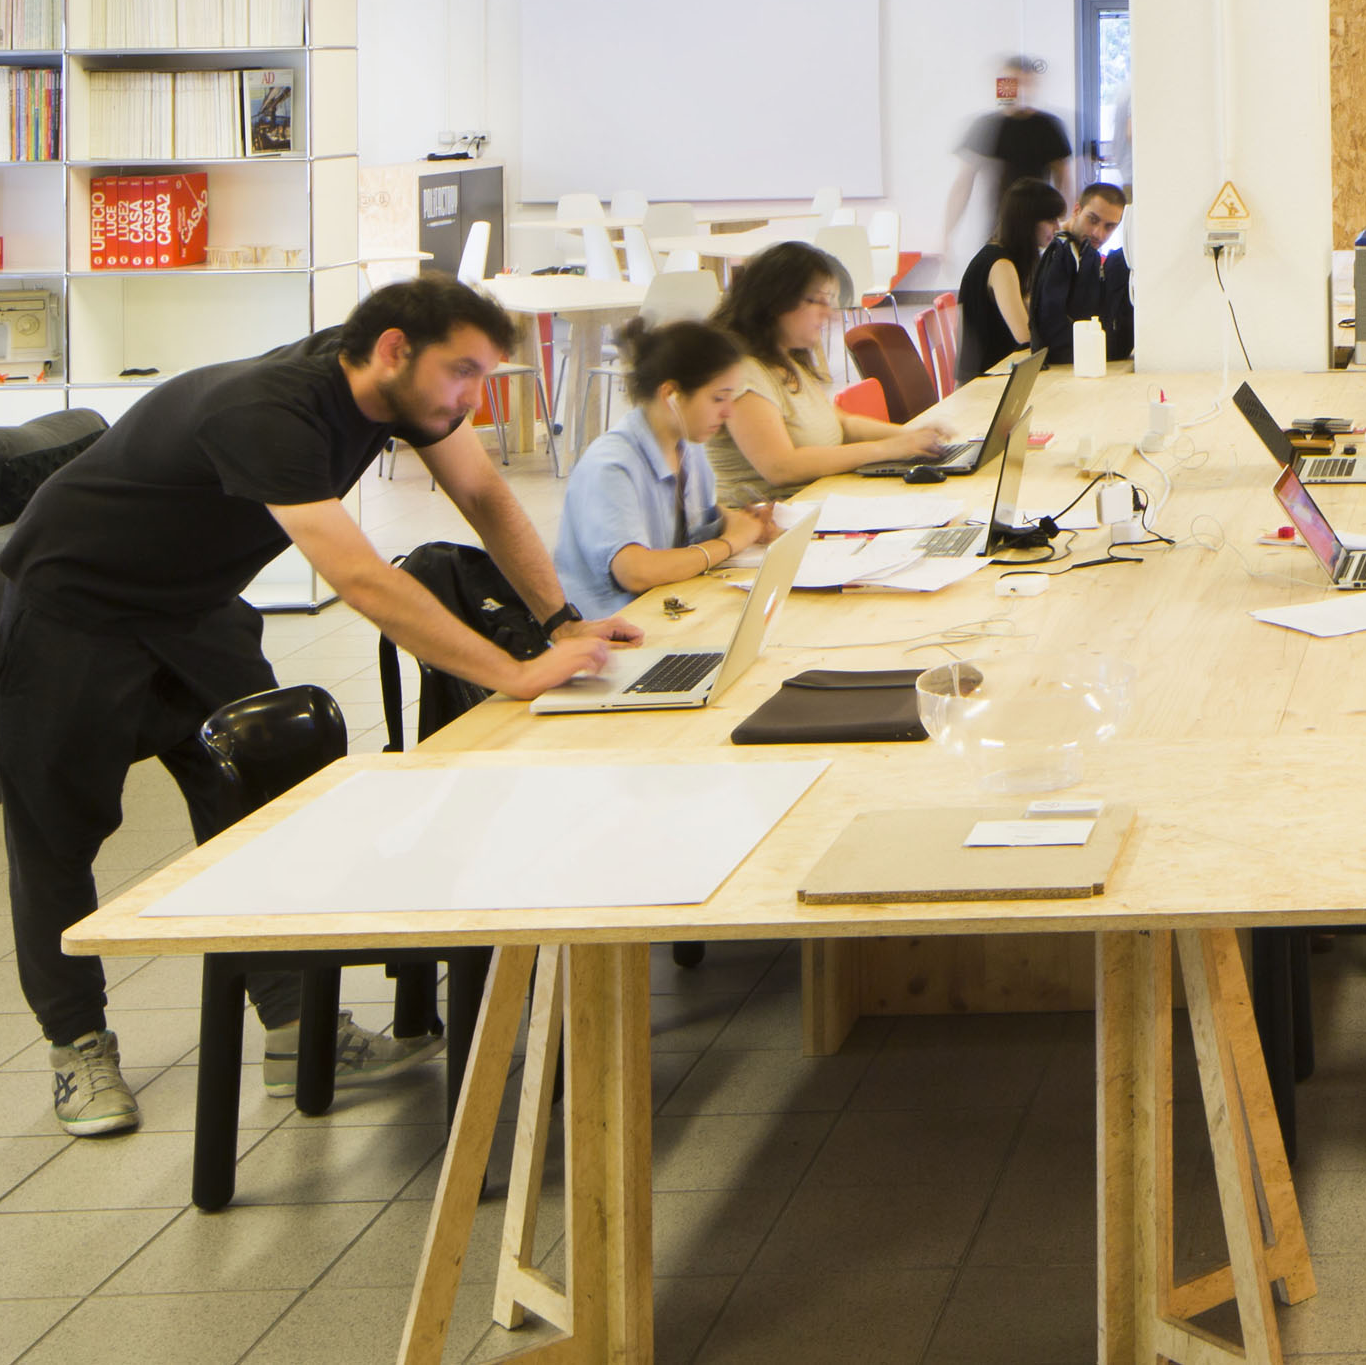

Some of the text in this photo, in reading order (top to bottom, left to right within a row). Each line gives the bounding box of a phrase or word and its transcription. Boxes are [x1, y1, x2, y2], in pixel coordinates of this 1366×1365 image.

[91, 192, 105, 251] UFFICIO
[106, 205, 117, 237] LUCE
[118, 200, 130, 241] LUCE2
[129, 199, 144, 243] CASA
[143, 200, 156, 242] CASA3
[156, 194, 171, 245] CASA2
